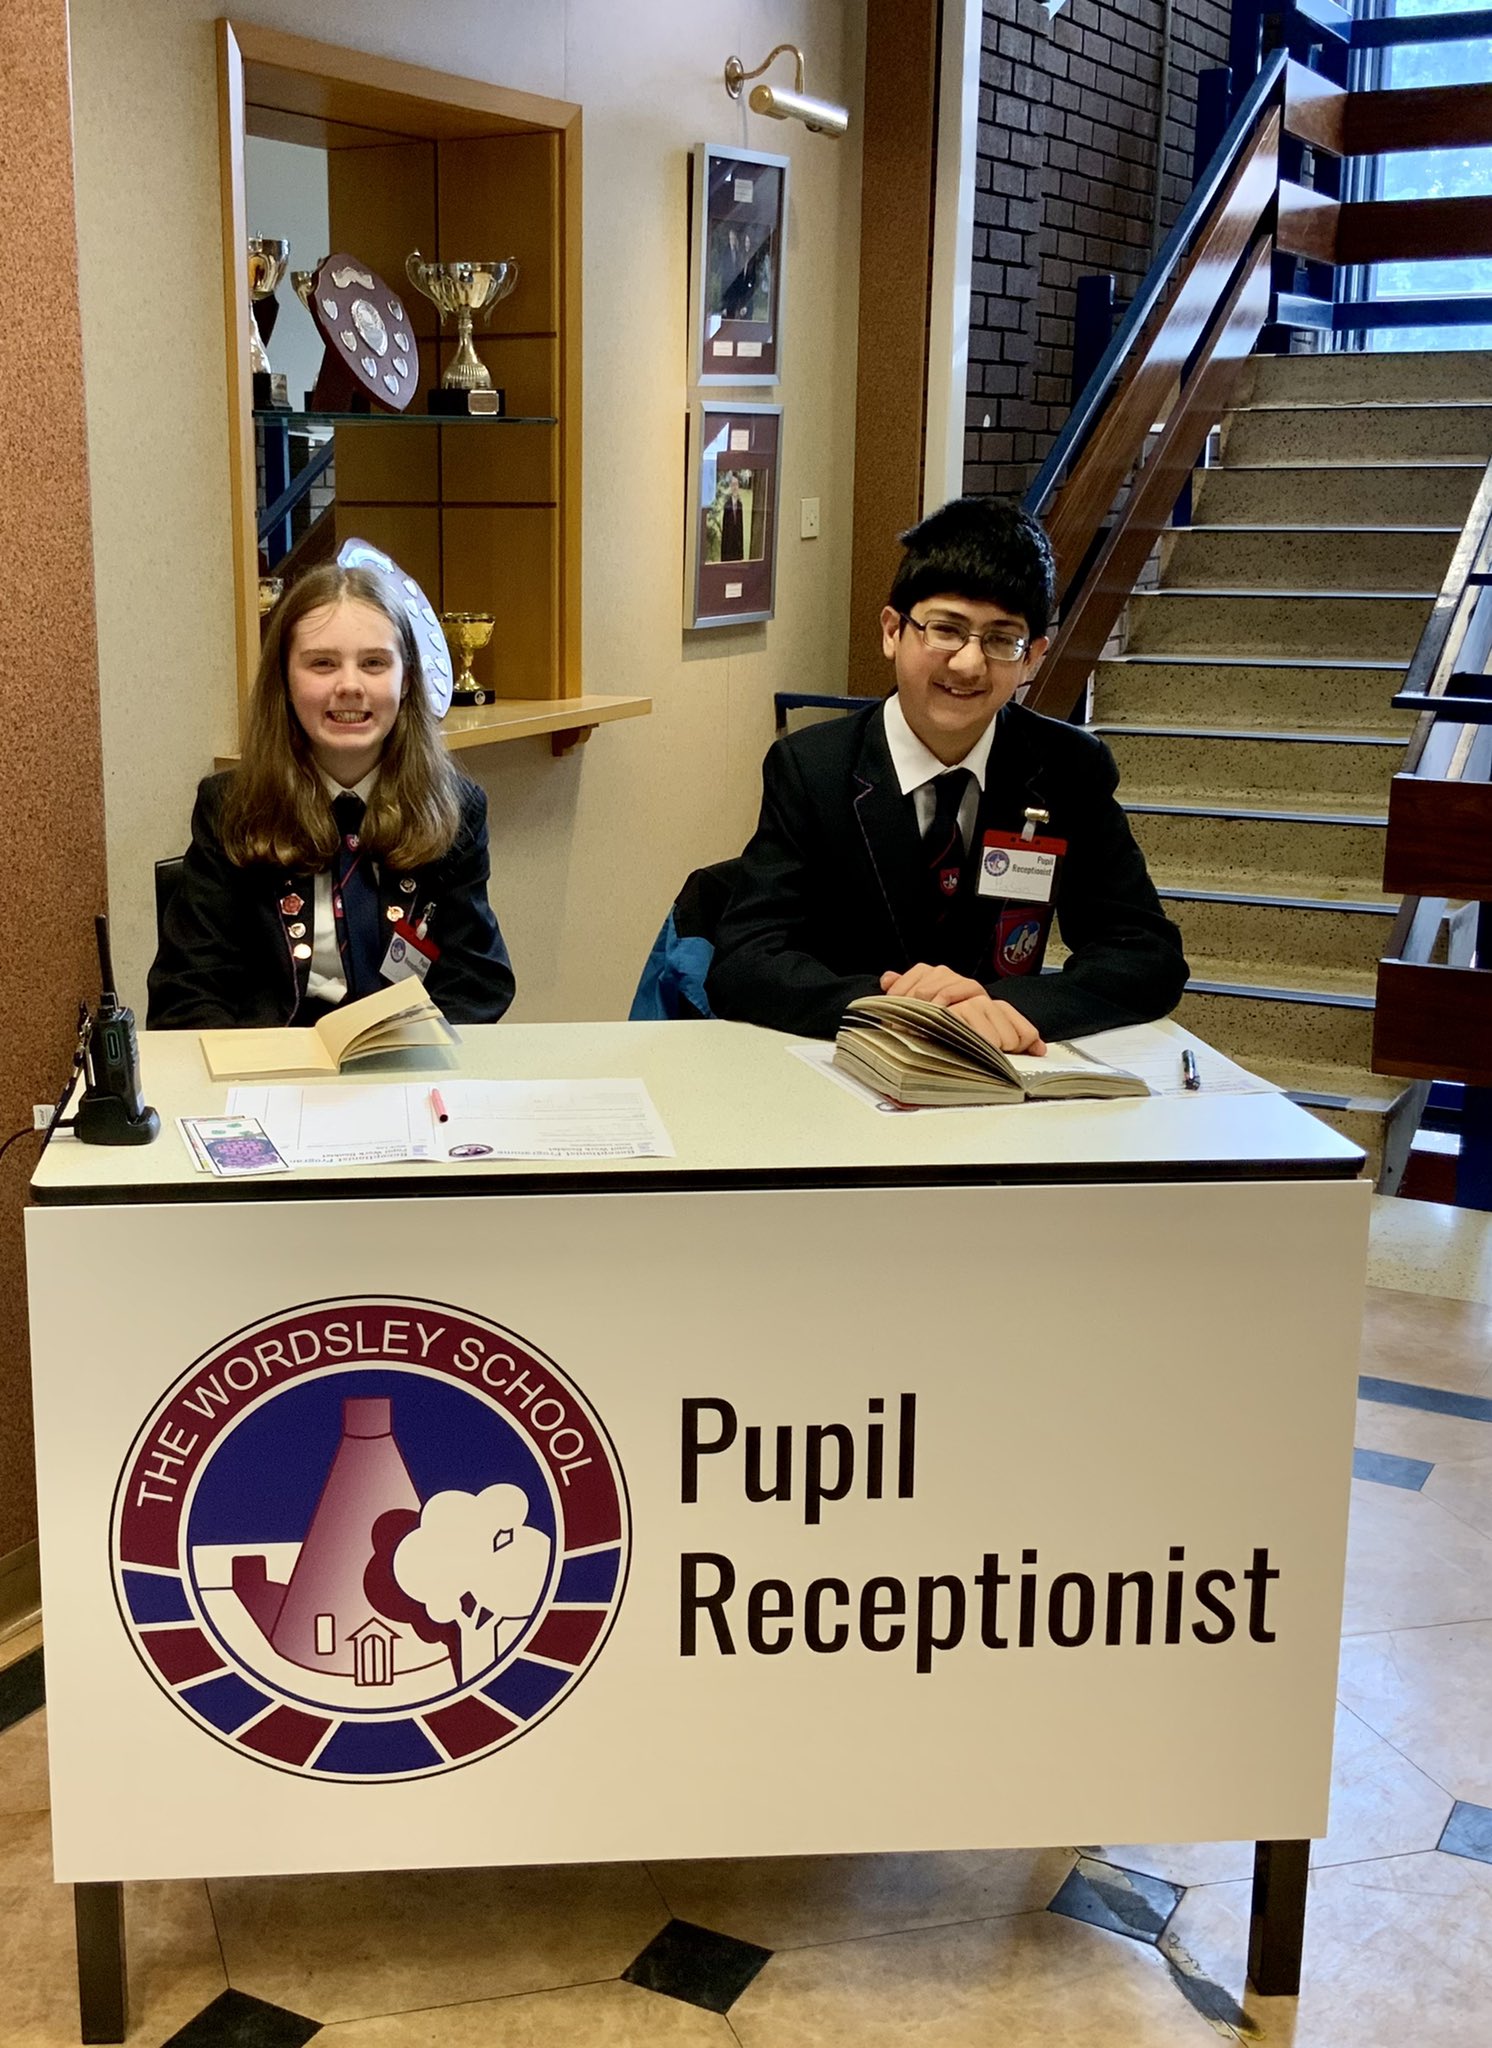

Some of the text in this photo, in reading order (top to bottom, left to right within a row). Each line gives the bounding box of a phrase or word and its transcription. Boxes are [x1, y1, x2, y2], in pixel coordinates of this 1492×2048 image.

[1012, 864, 1052, 876] Receptionist
[137, 1319, 593, 1508] THE WORDSLEY SCHOOL
[681, 1392, 917, 1525] Pupil
[680, 1545, 1281, 1674] Receptionist
